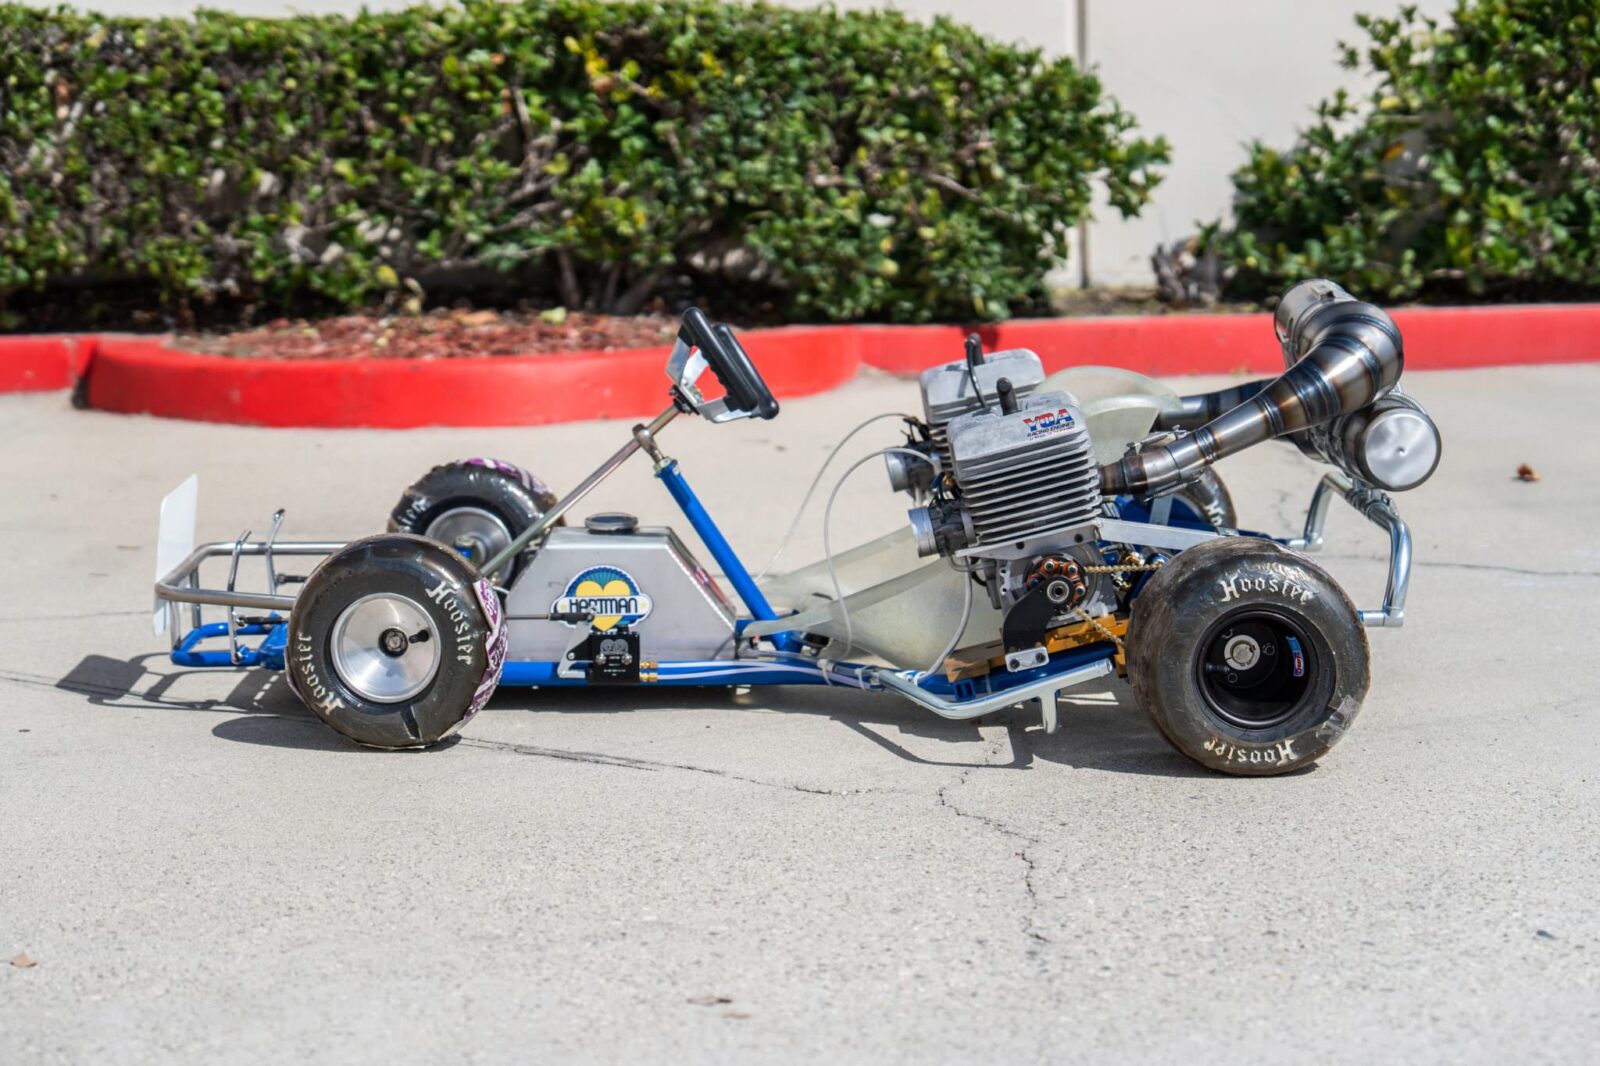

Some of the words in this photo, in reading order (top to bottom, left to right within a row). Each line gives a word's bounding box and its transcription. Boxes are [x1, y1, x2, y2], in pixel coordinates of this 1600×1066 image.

[1027, 428, 1050, 438] RACING
[1050, 421, 1075, 432] ENGINES
[1220, 573, 1314, 605] Hoosier
